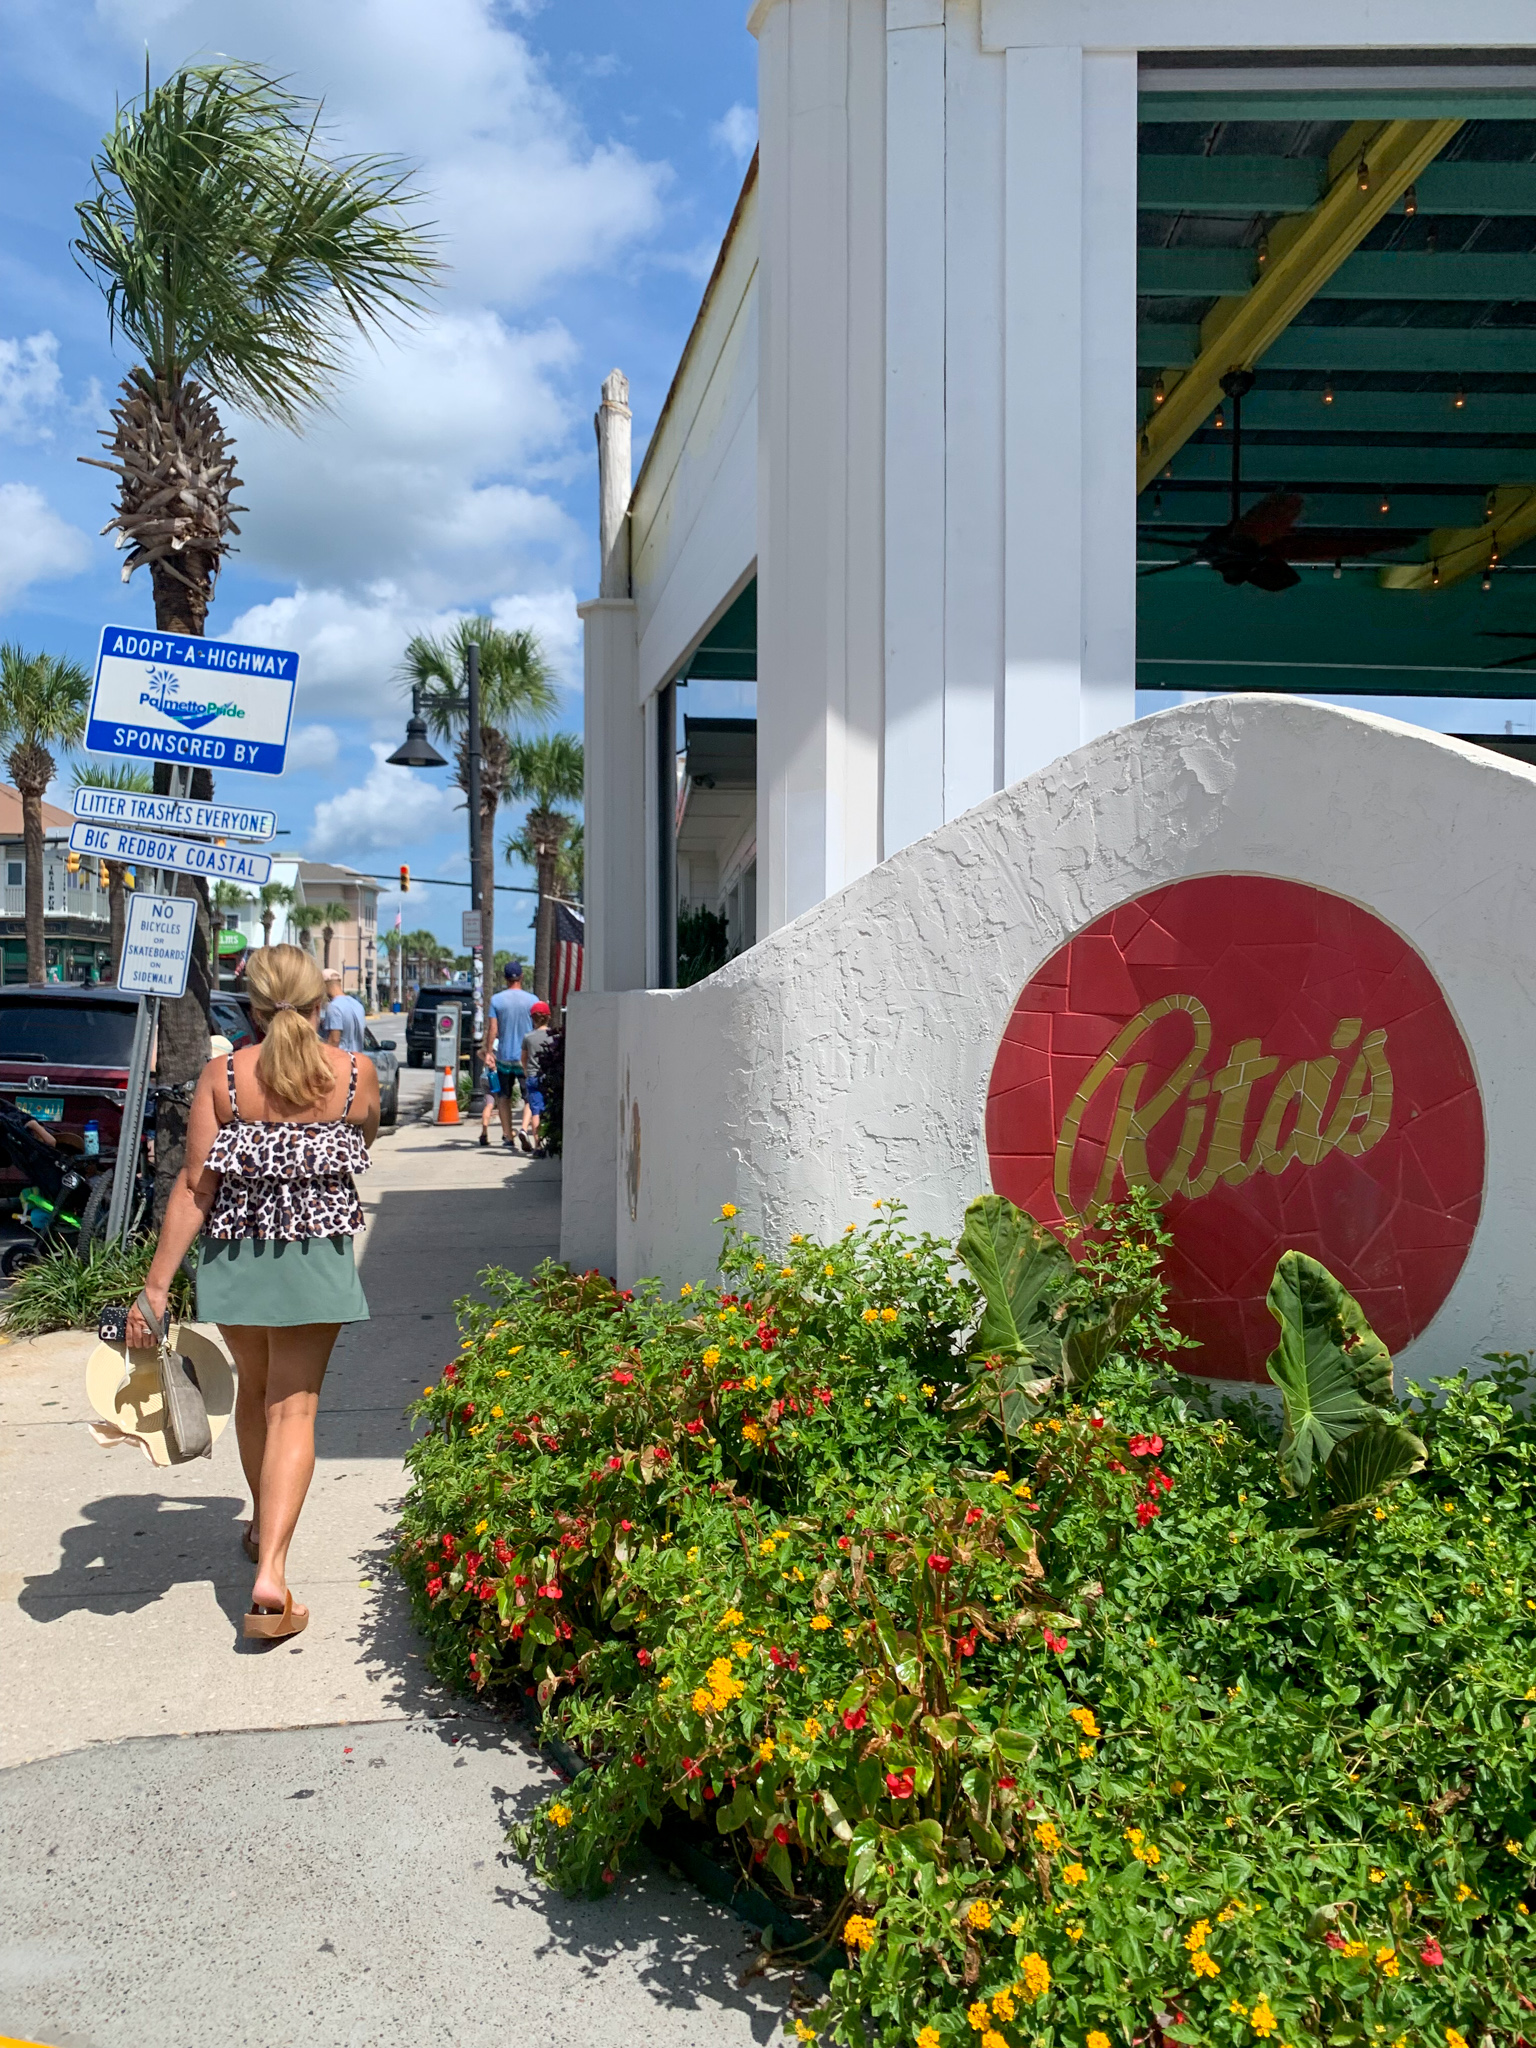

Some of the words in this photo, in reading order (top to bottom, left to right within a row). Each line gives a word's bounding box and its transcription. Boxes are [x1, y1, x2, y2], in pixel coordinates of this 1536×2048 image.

[112, 635, 288, 675] ADOPT-A-HIGHWAY
[113, 728, 226, 760] SPONSORED
[233, 744, 260, 765] BY
[81, 793, 126, 816] LITTER
[130, 799, 193, 825] TRASHES
[196, 808, 268, 833] EVERYONE
[84, 829, 110, 849] BIG
[117, 835, 178, 862] REDBOX
[186, 847, 255, 877] COASTAL
[151, 904, 174, 919] NO
[140, 920, 181, 935] BICYCLES
[128, 944, 186, 961] SKATEBOARDS
[150, 961, 161, 969] ON
[133, 971, 174, 985] SIDEWALK
[1054, 994, 1394, 1228] Rita's
